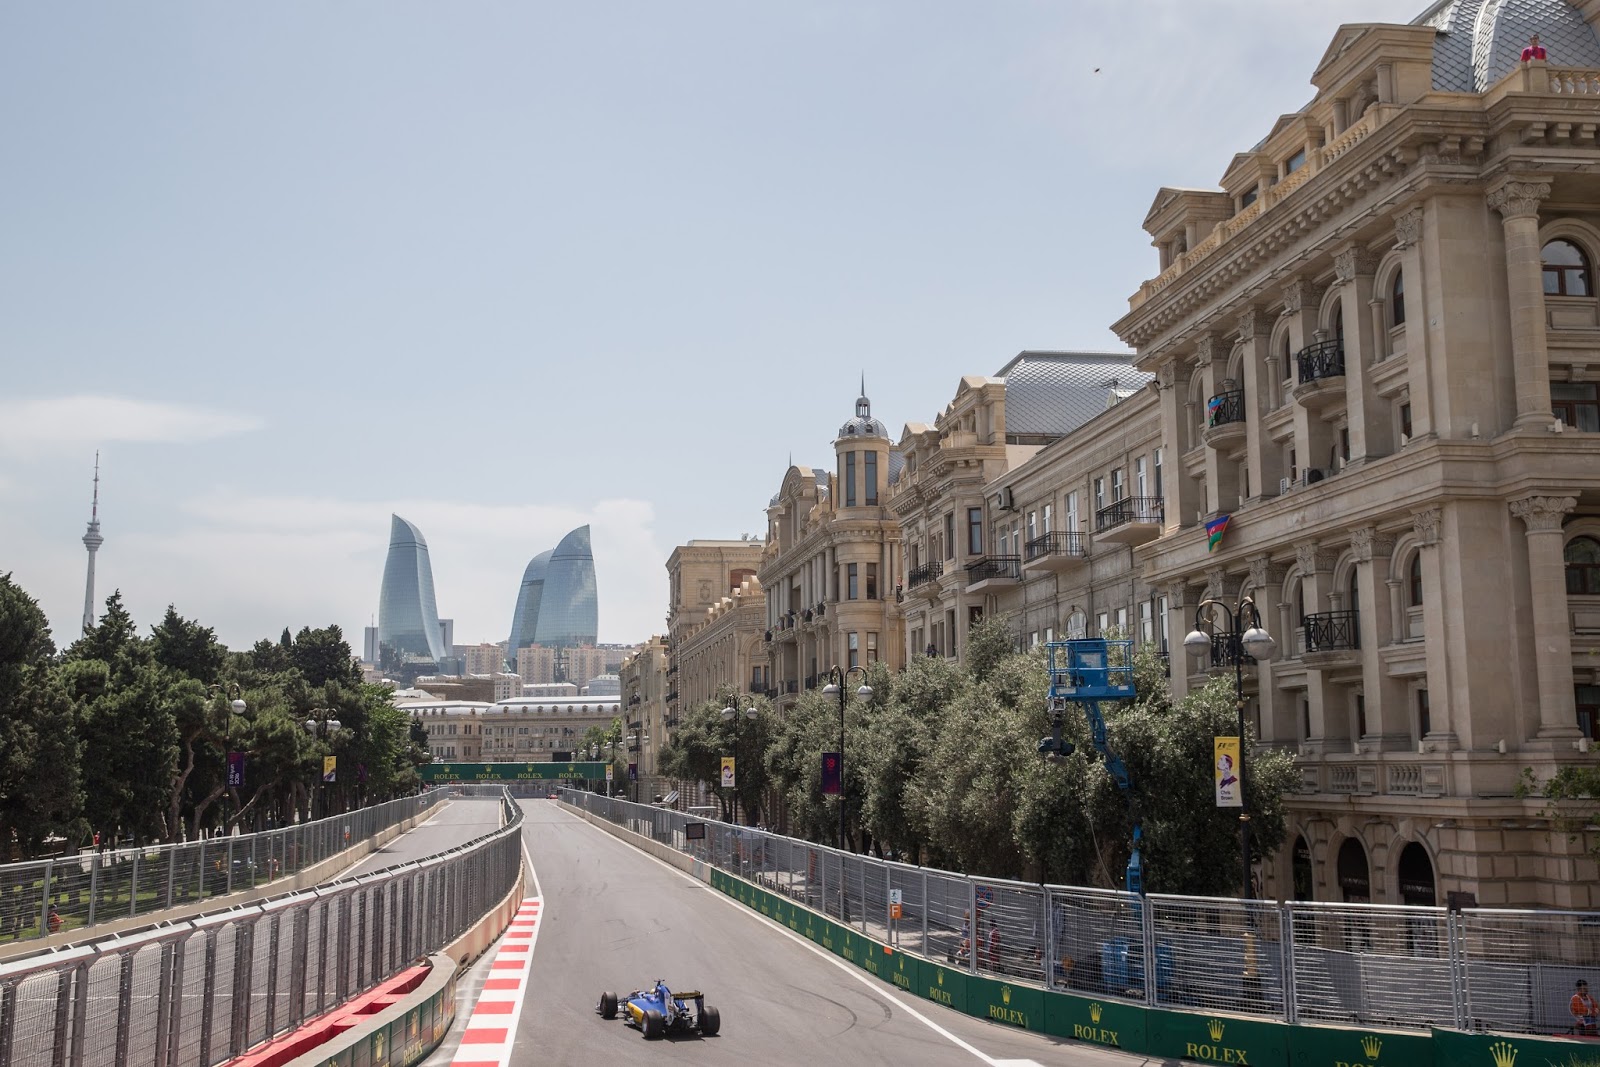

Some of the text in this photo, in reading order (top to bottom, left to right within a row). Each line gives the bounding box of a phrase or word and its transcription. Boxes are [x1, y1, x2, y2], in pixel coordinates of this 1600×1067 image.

[891, 905, 899, 917] F
[929, 986, 952, 1004] ROLEX
[989, 1004, 1025, 1025] ROLEX
[1074, 1023, 1119, 1046] ROLEX
[403, 1038, 424, 1067] ROLEX
[1186, 1042, 1248, 1065] ROLEX
